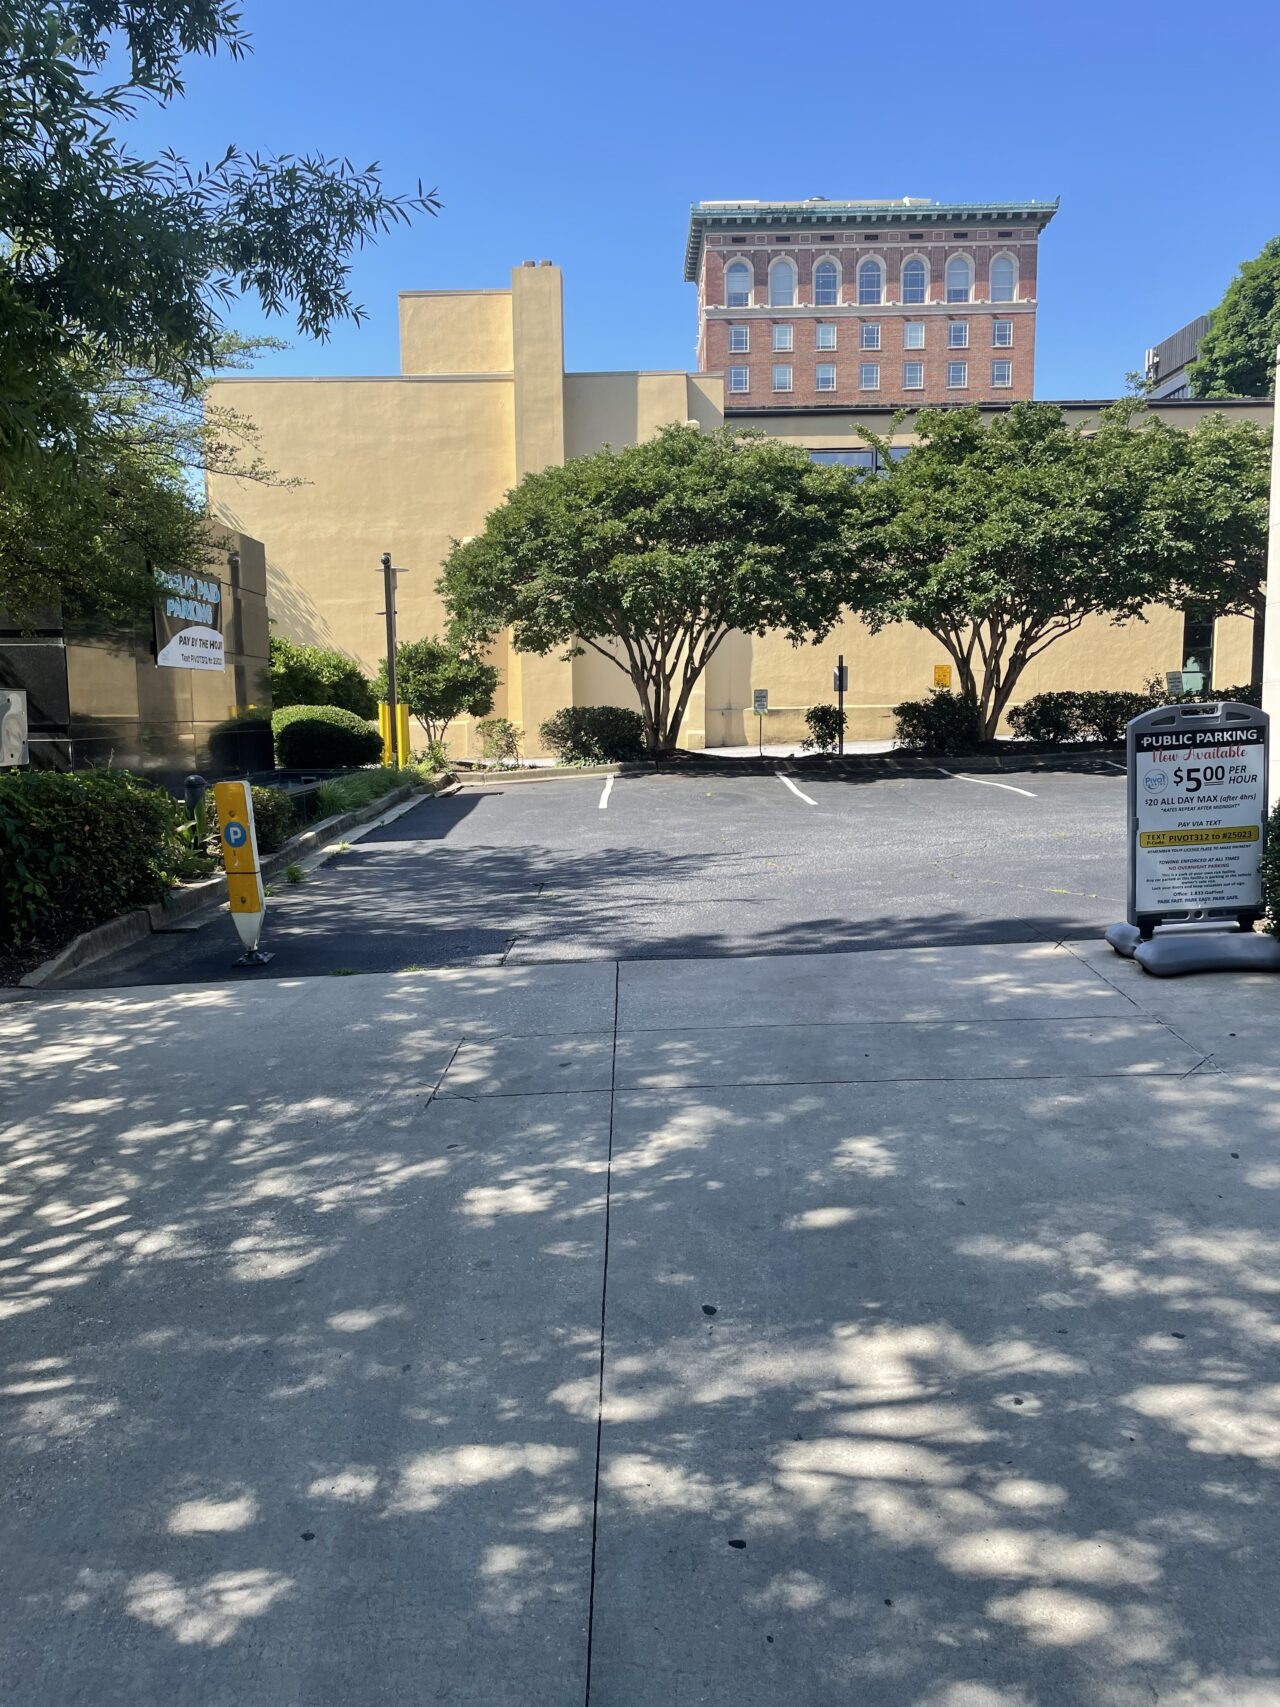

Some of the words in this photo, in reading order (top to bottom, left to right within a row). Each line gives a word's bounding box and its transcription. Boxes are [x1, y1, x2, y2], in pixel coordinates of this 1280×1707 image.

[167, 596, 212, 624] PARKING
[179, 635, 190, 646] PAY
[198, 638, 208, 649] THE
[1144, 734, 1192, 746] PUBLIC
[1196, 730, 1257, 743] PARKING
[1152, 749, 1178, 762] Now
[1184, 743, 1247, 760] Available
[1229, 765, 1246, 774] PER
[1228, 775, 1257, 784] HOUR
[1178, 796, 1195, 804] DAY
[230, 826, 242, 844] P
[1168, 833, 1209, 842] PIVOT312
[1222, 831, 1252, 839] #25023
